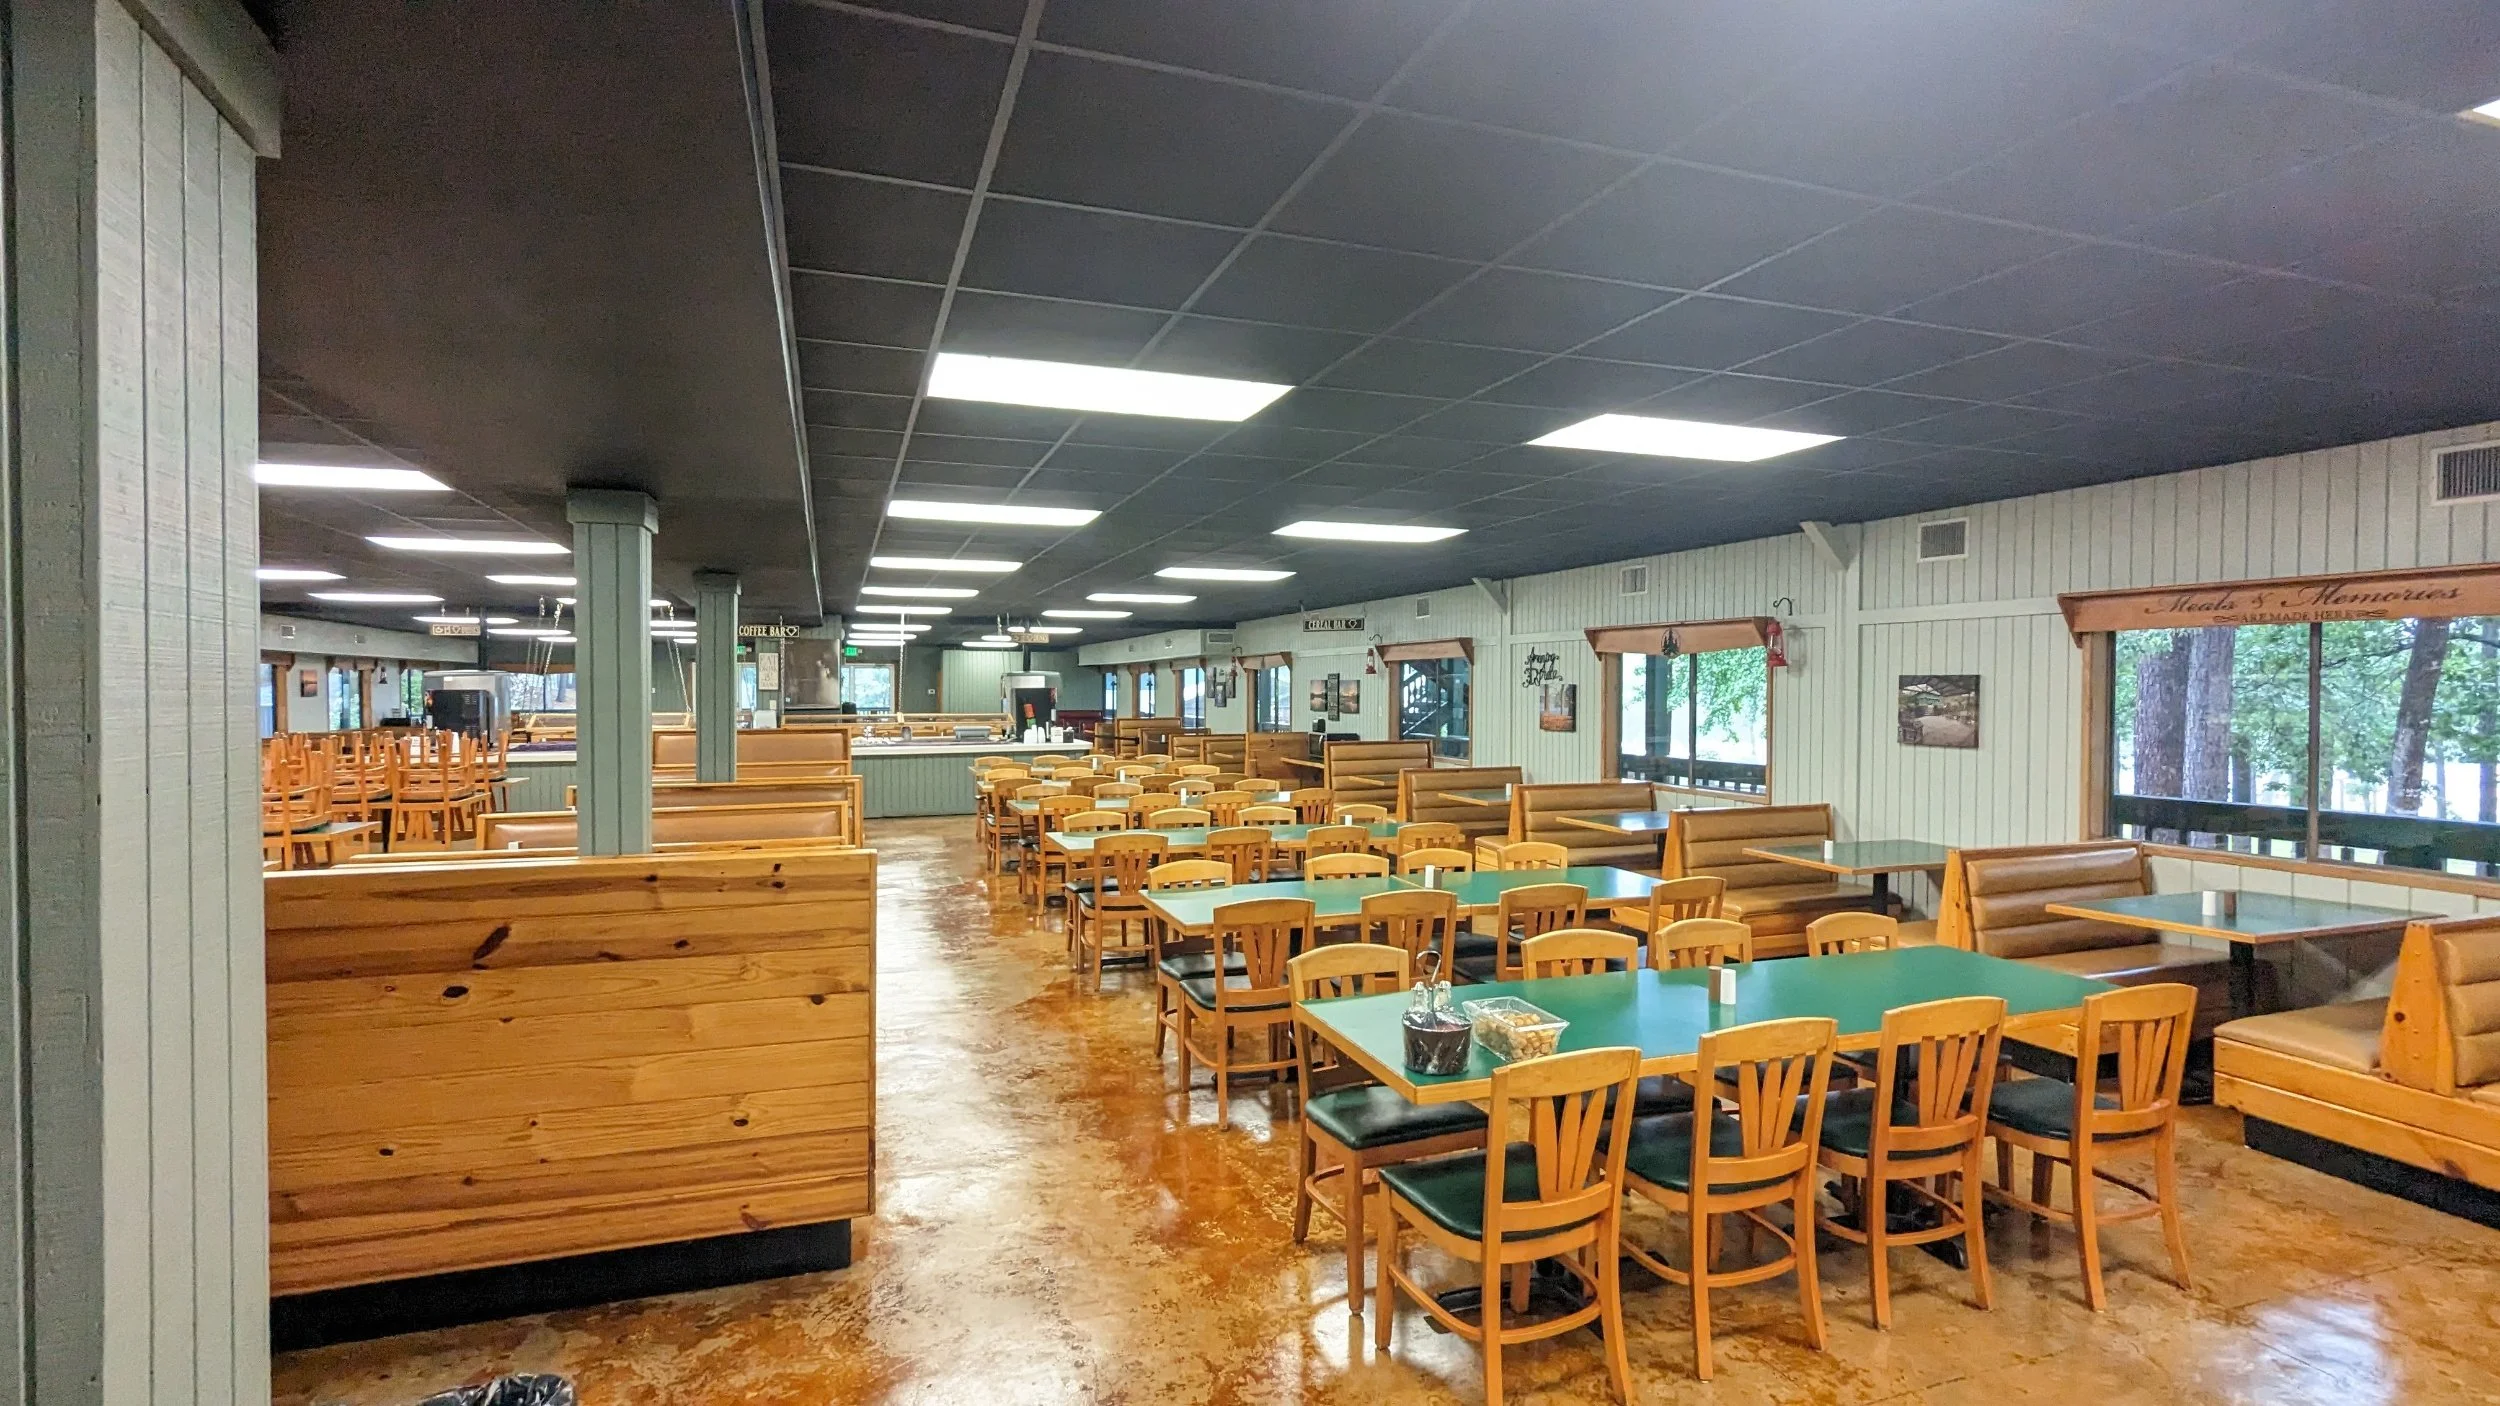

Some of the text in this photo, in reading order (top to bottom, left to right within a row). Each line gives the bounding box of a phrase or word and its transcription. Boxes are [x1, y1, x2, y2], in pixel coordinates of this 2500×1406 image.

[2144, 581, 2463, 614] Meals & Memories
[2240, 609, 2354, 623] ARE MADE HERE
[739, 625, 786, 637] COFFEE BAR
